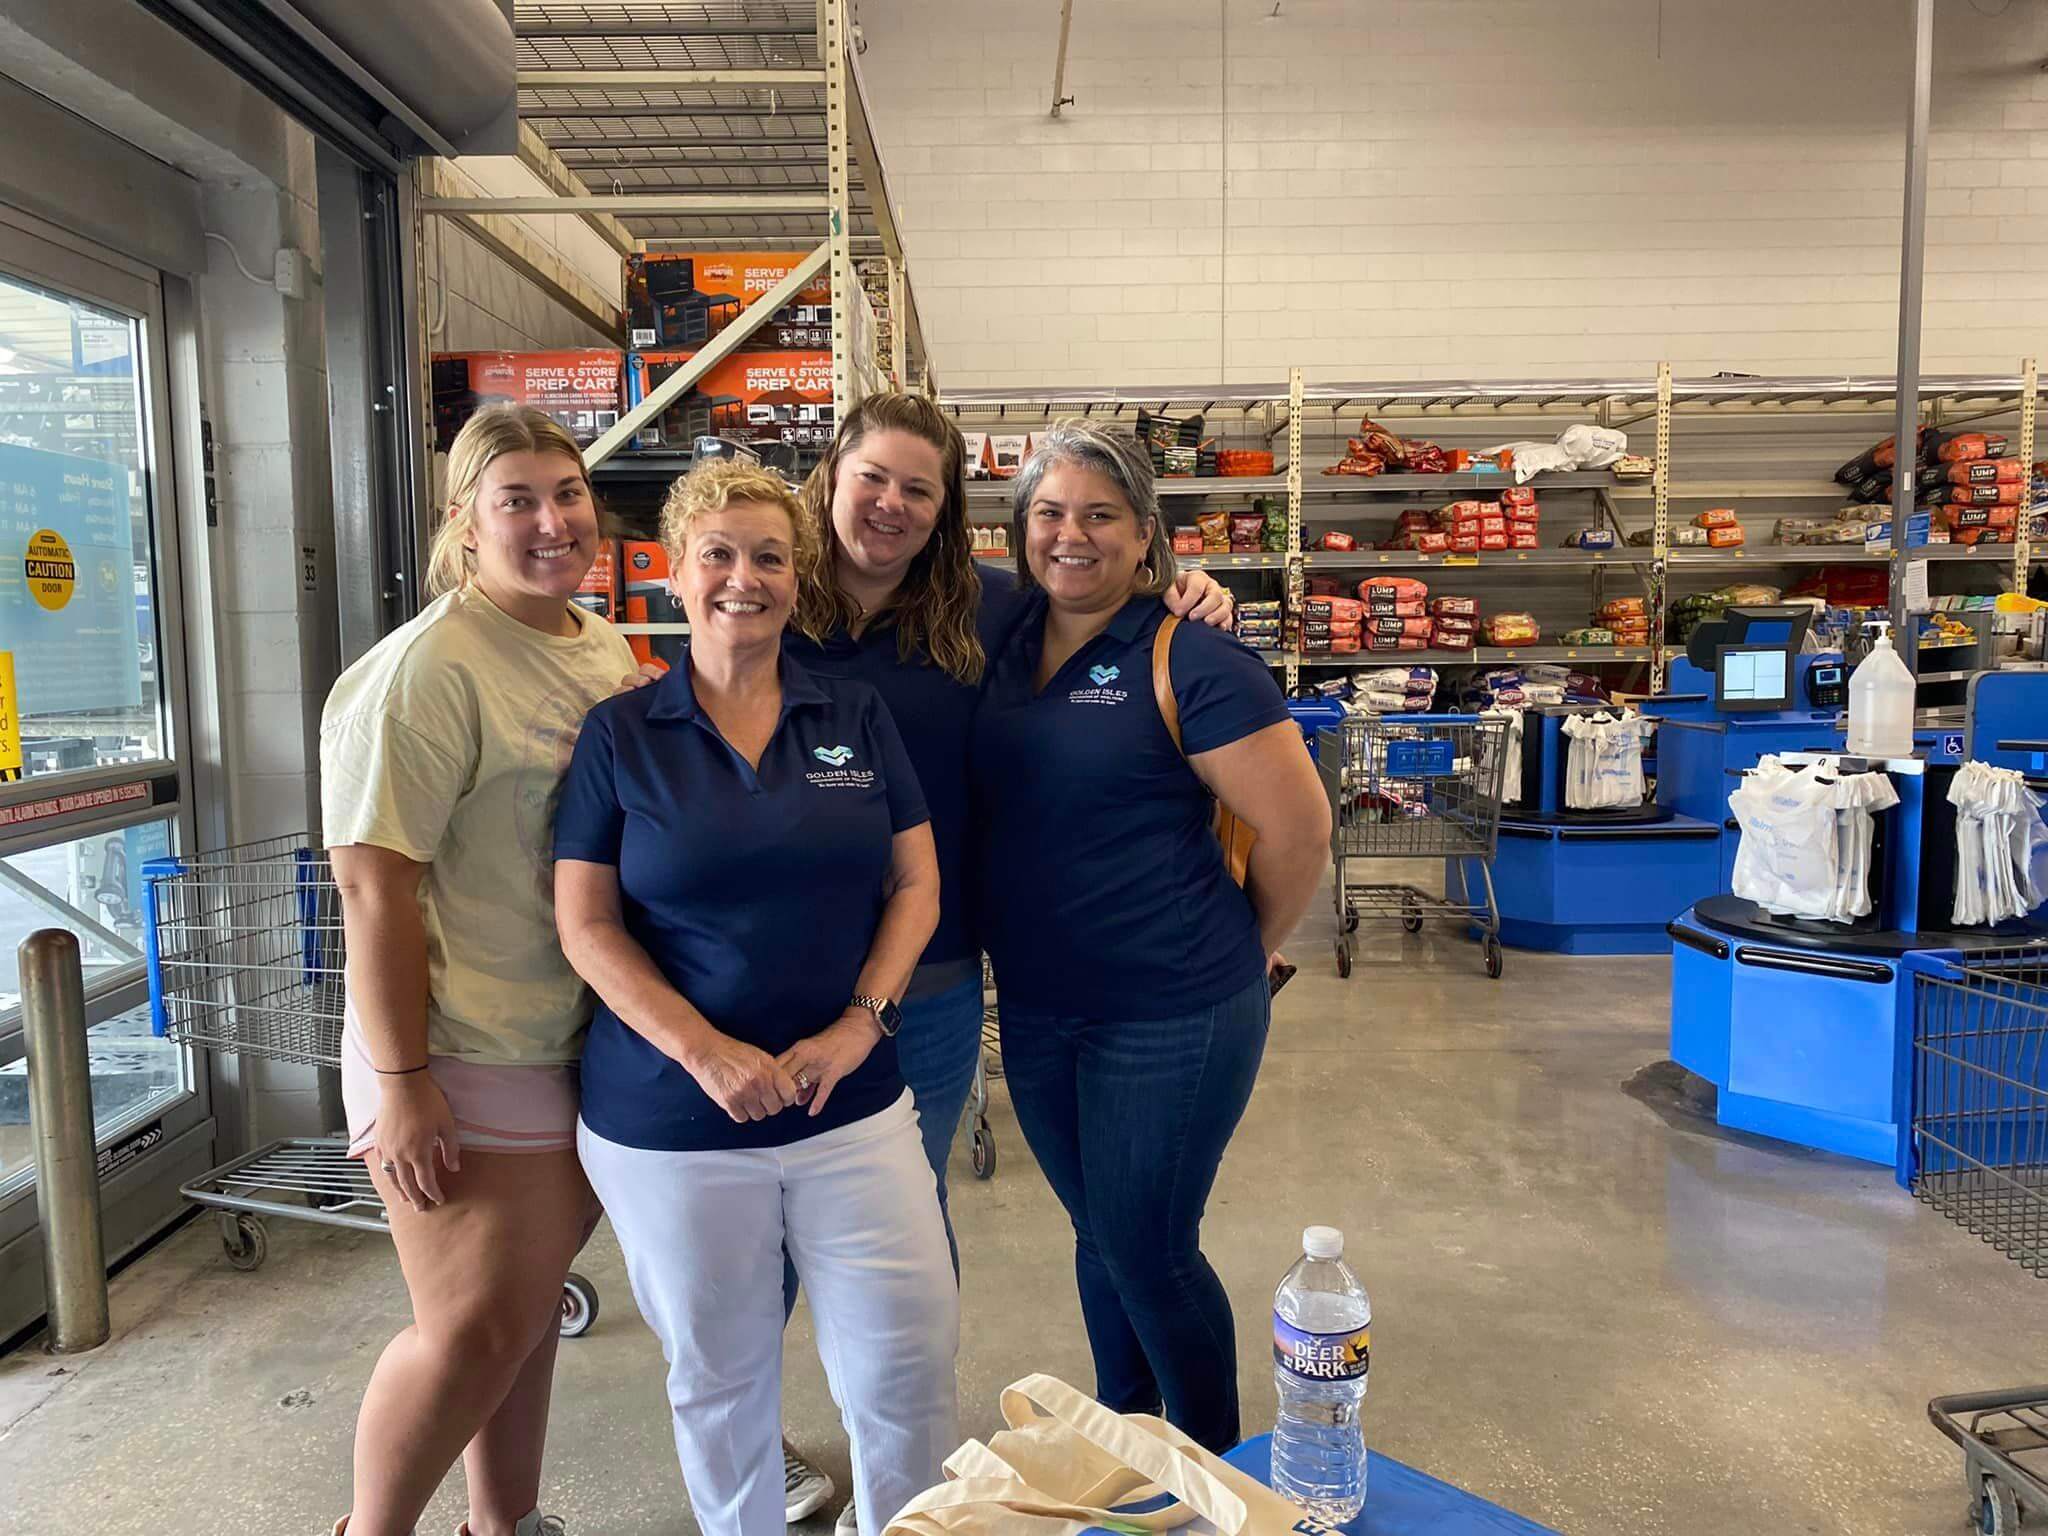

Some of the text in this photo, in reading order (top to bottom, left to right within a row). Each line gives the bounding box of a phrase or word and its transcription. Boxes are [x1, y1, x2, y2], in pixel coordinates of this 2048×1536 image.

[744, 268, 785, 278] SERVE
[744, 279, 777, 291] PRE
[525, 367, 616, 378] SERVE & STORE
[746, 368, 786, 377] SERVE
[789, 368, 797, 378] &
[525, 379, 617, 391] PREP CART
[746, 379, 791, 391] PREP
[1971, 469, 1996, 477] LUMP
[1974, 488, 1998, 496] LUMP
[1961, 513, 1987, 522] LUMP
[29, 546, 70, 559] AUTOMATIC
[27, 561, 73, 578] CAUTION
[304, 564, 316, 582] 33
[41, 582, 62, 594] DOOR
[1371, 586, 1395, 594] LUMP
[1306, 603, 1330, 612] LUMP
[1305, 624, 1329, 632] LUMP
[1374, 636, 1397, 644] LUMP
[1102, 688, 1127, 698] ISLES
[806, 770, 848, 780] GOLDEN
[1295, 1340, 1346, 1361] DEER
[1294, 1356, 1347, 1379] PARK
